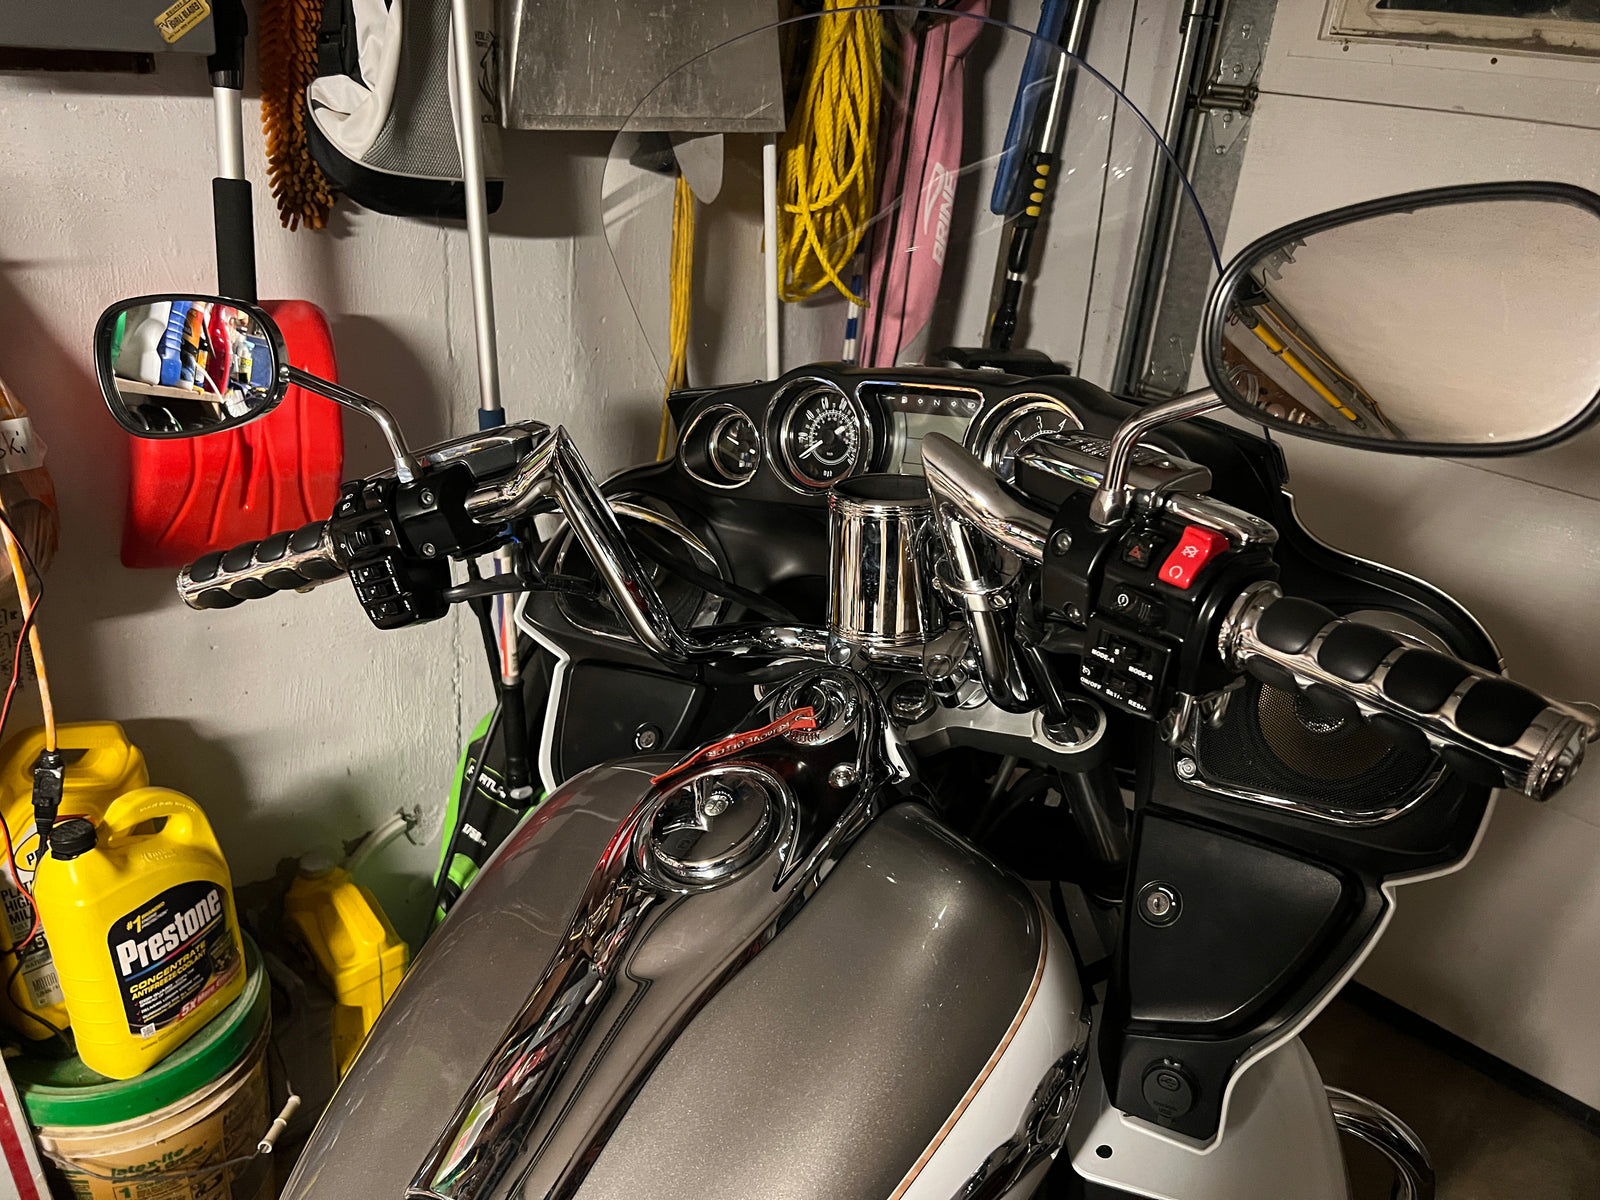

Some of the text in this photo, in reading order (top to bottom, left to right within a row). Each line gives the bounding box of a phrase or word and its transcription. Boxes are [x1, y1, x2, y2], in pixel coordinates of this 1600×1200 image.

[932, 170, 954, 267] BRINE
[115, 888, 221, 977] Prestone
[126, 915, 142, 933] #1
[129, 940, 206, 994] CONCENTRATE
